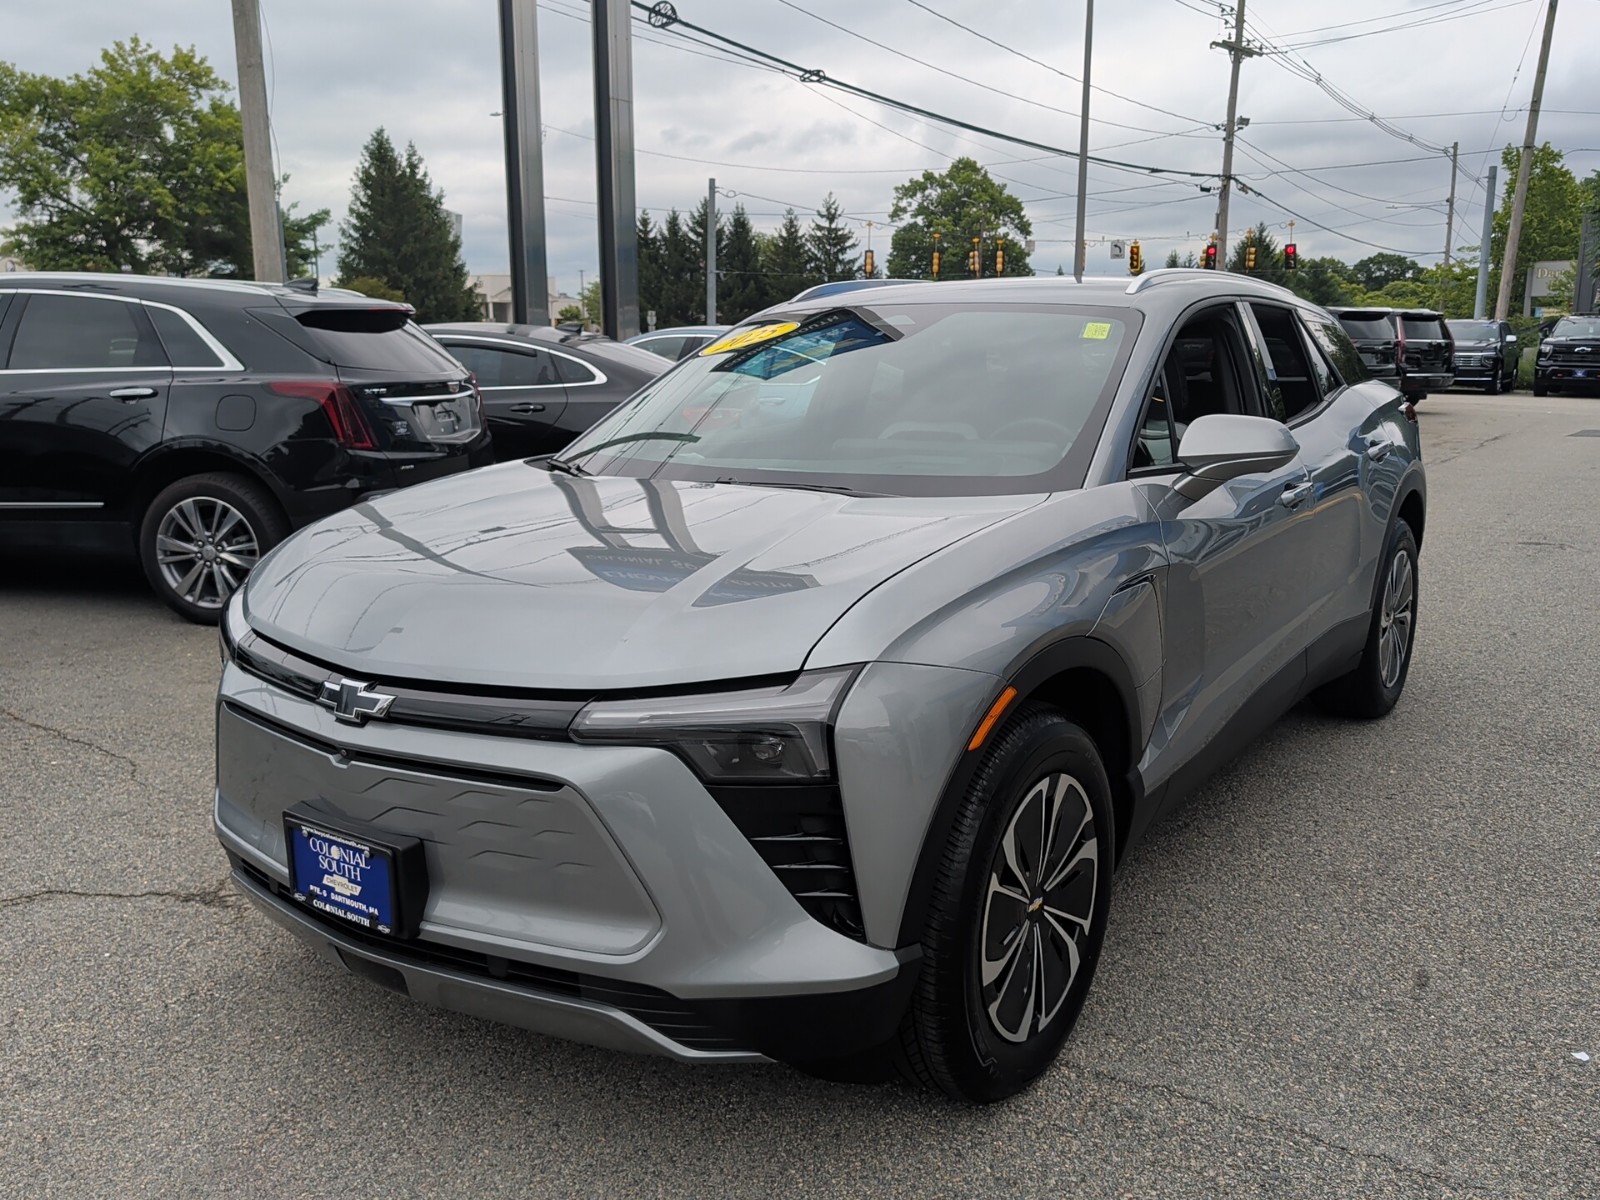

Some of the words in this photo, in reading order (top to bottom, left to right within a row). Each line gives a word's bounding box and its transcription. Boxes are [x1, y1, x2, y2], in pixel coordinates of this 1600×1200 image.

[309, 837, 371, 869] COLONIAL
[318, 855, 362, 881] SOUTH
[325, 876, 359, 893] CHEVROLET
[313, 899, 347, 917] COLONIAL
[346, 912, 370, 927] SOUTH
[331, 892, 369, 913] DARTMOUTH,
